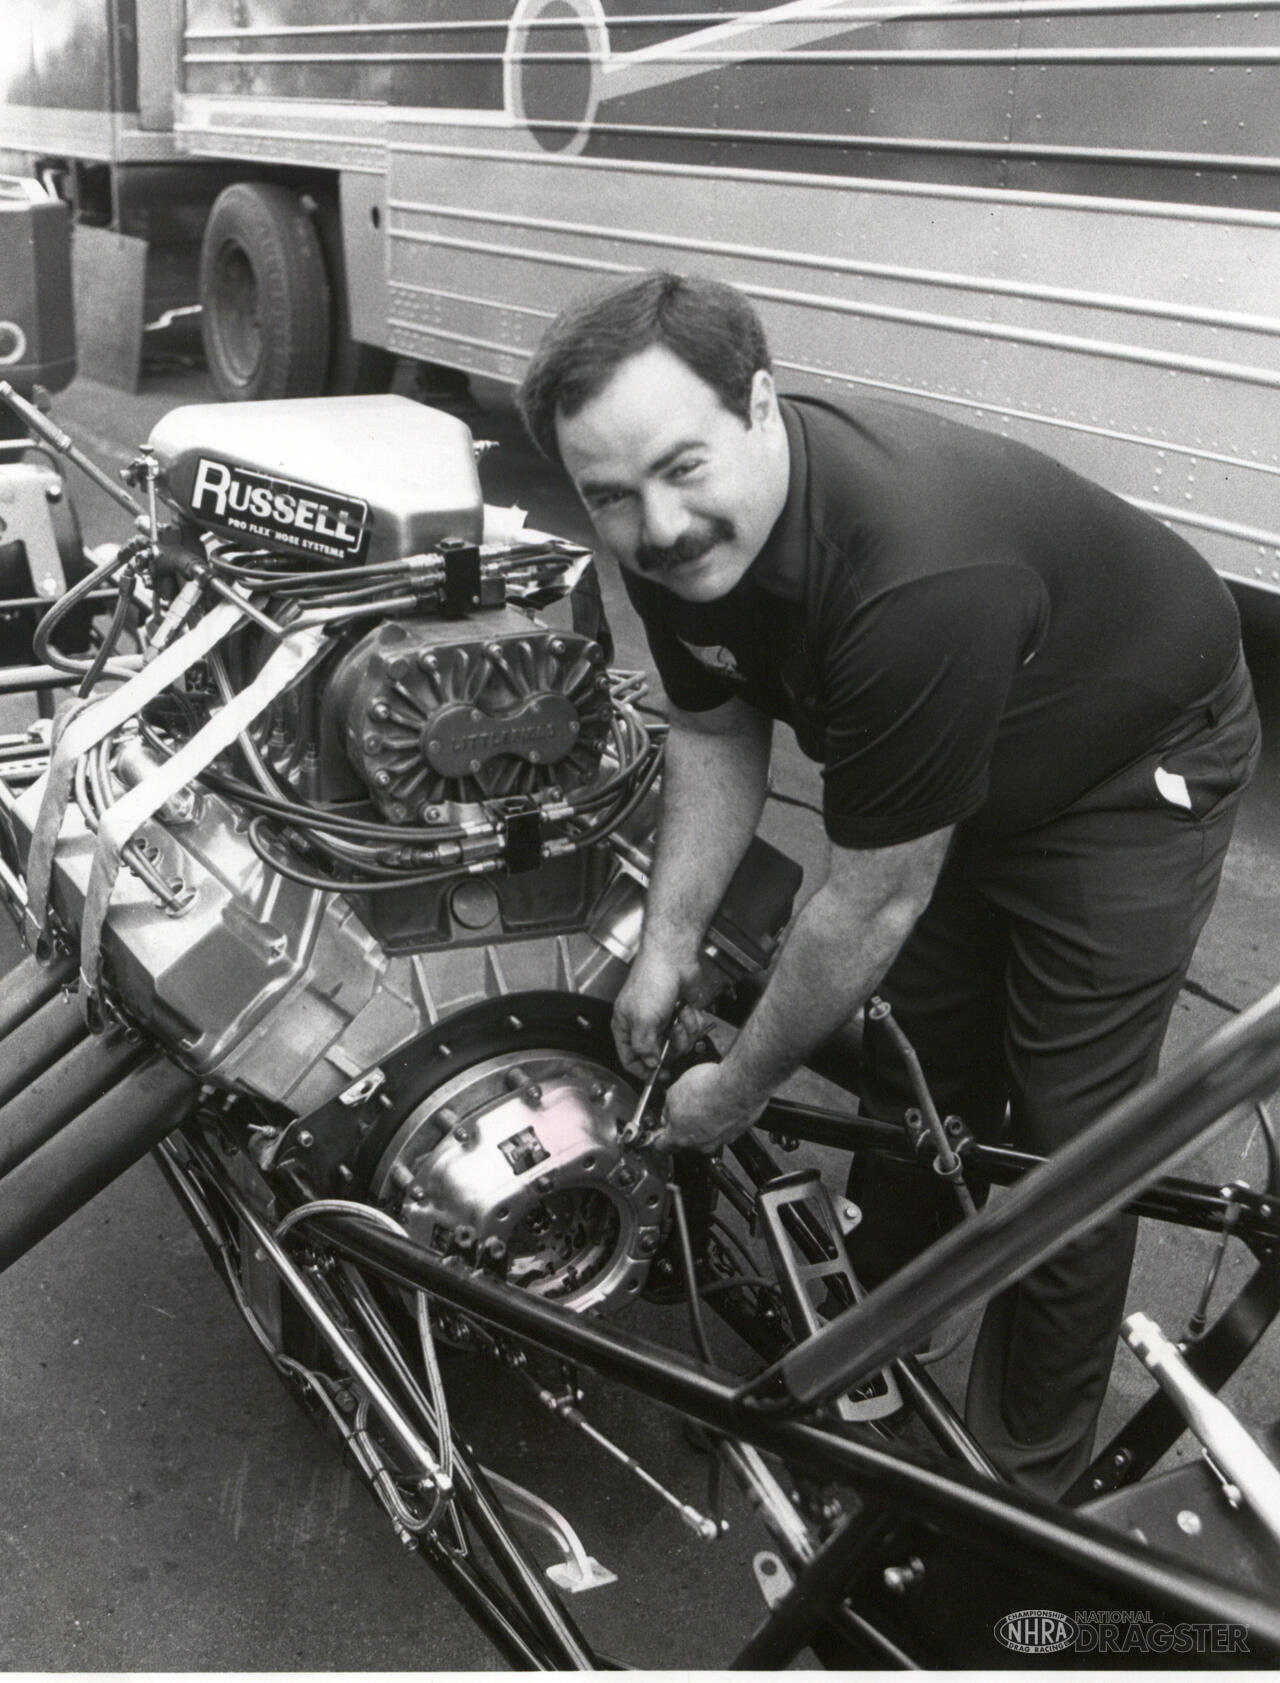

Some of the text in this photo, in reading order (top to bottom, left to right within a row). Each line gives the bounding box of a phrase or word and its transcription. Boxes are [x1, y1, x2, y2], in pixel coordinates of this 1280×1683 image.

[191, 458, 356, 543] RUSSELL
[227, 517, 248, 531] PRO
[275, 531, 300, 546] HOSE
[302, 538, 345, 559] SYSTEMS
[451, 723, 556, 749] LITTLEFIELD
